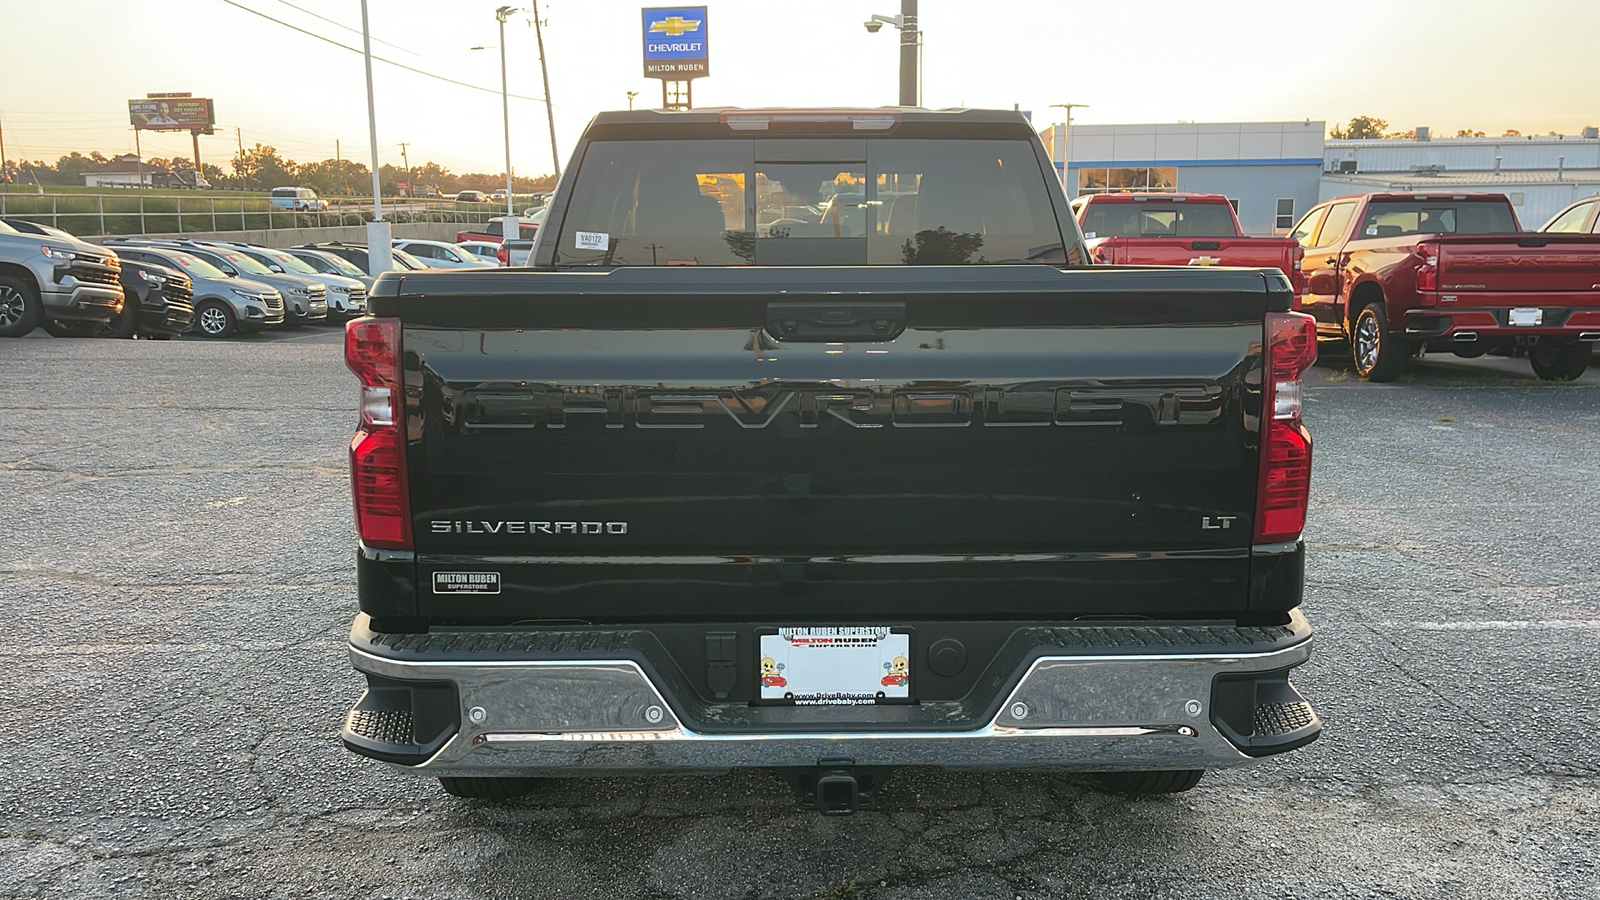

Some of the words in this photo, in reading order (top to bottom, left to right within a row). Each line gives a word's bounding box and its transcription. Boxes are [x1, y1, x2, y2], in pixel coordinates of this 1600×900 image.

[648, 43, 702, 52] CHEVROLET
[463, 386, 1208, 428] CHEVROLET
[431, 520, 628, 534] SILVERADO
[1202, 516, 1237, 529] LT
[437, 574, 468, 583] MILTON
[469, 574, 497, 583] RUBEN
[778, 627, 809, 636] MILTON
[810, 627, 838, 635] RUBEN
[838, 626, 891, 635] SUPERSTORE
